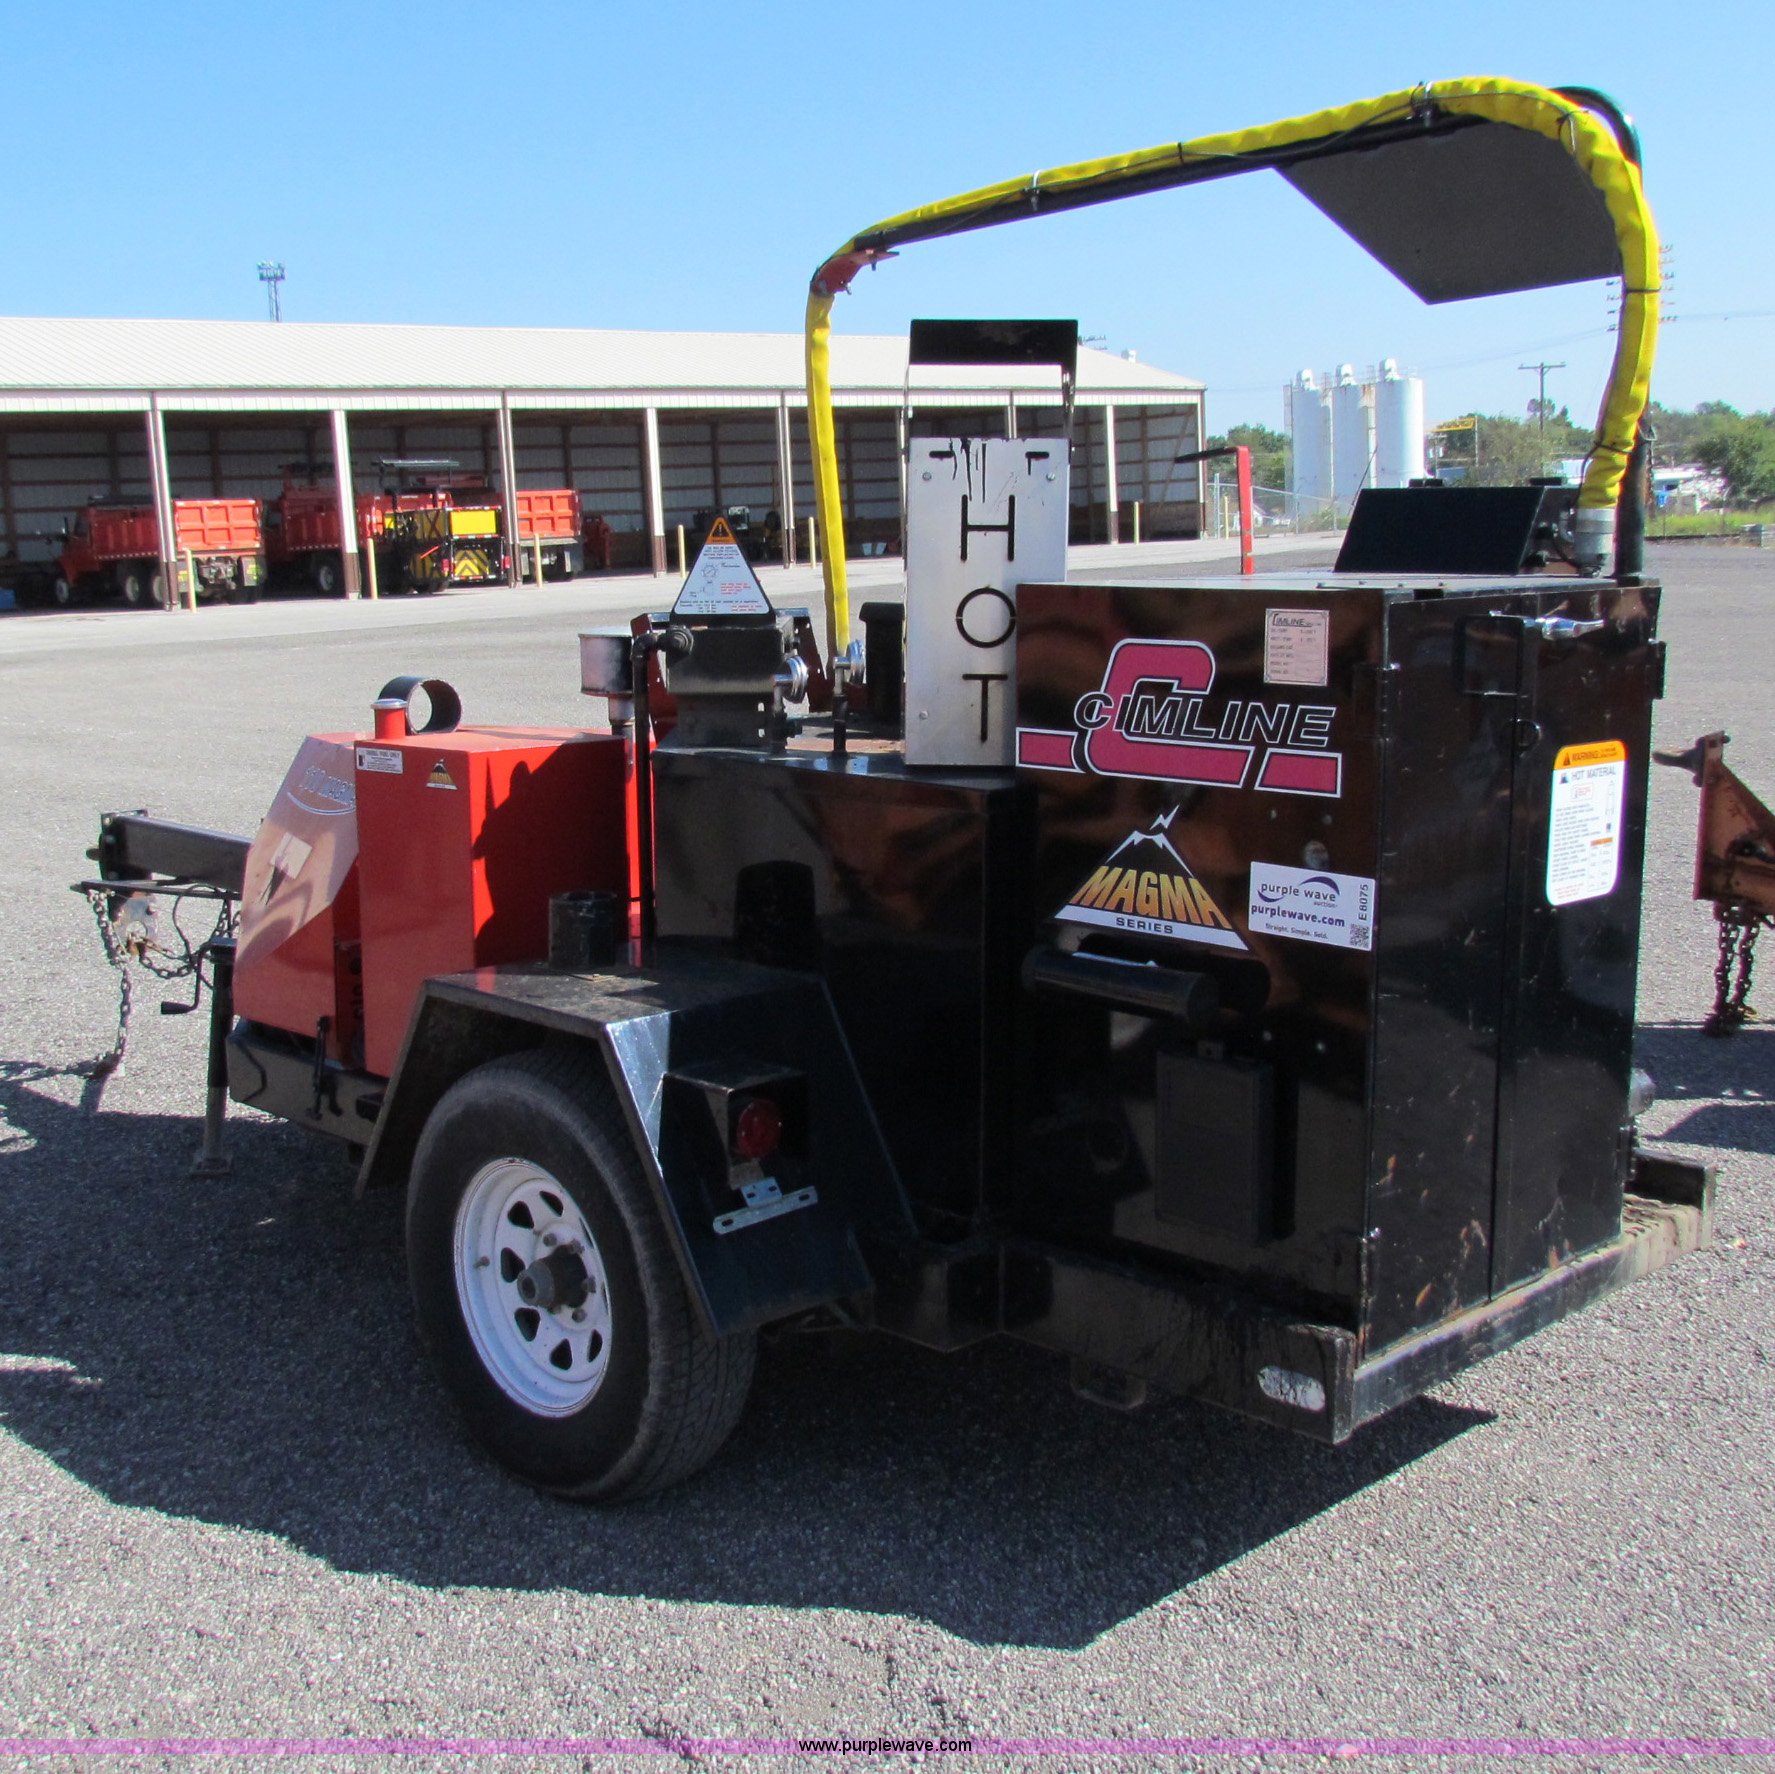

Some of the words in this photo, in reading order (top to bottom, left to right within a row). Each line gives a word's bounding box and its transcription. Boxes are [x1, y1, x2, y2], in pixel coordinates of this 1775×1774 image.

[956, 494, 1017, 743] HOT
[1074, 691, 1336, 748] CIMLINE
[1069, 865, 1233, 930] MAGMA
[1261, 883, 1300, 897] purple
[1304, 889, 1337, 902] wave
[1358, 884, 1369, 921] E8075
[1115, 917, 1174, 935] SERIES
[1251, 904, 1345, 927] purplewave.com
